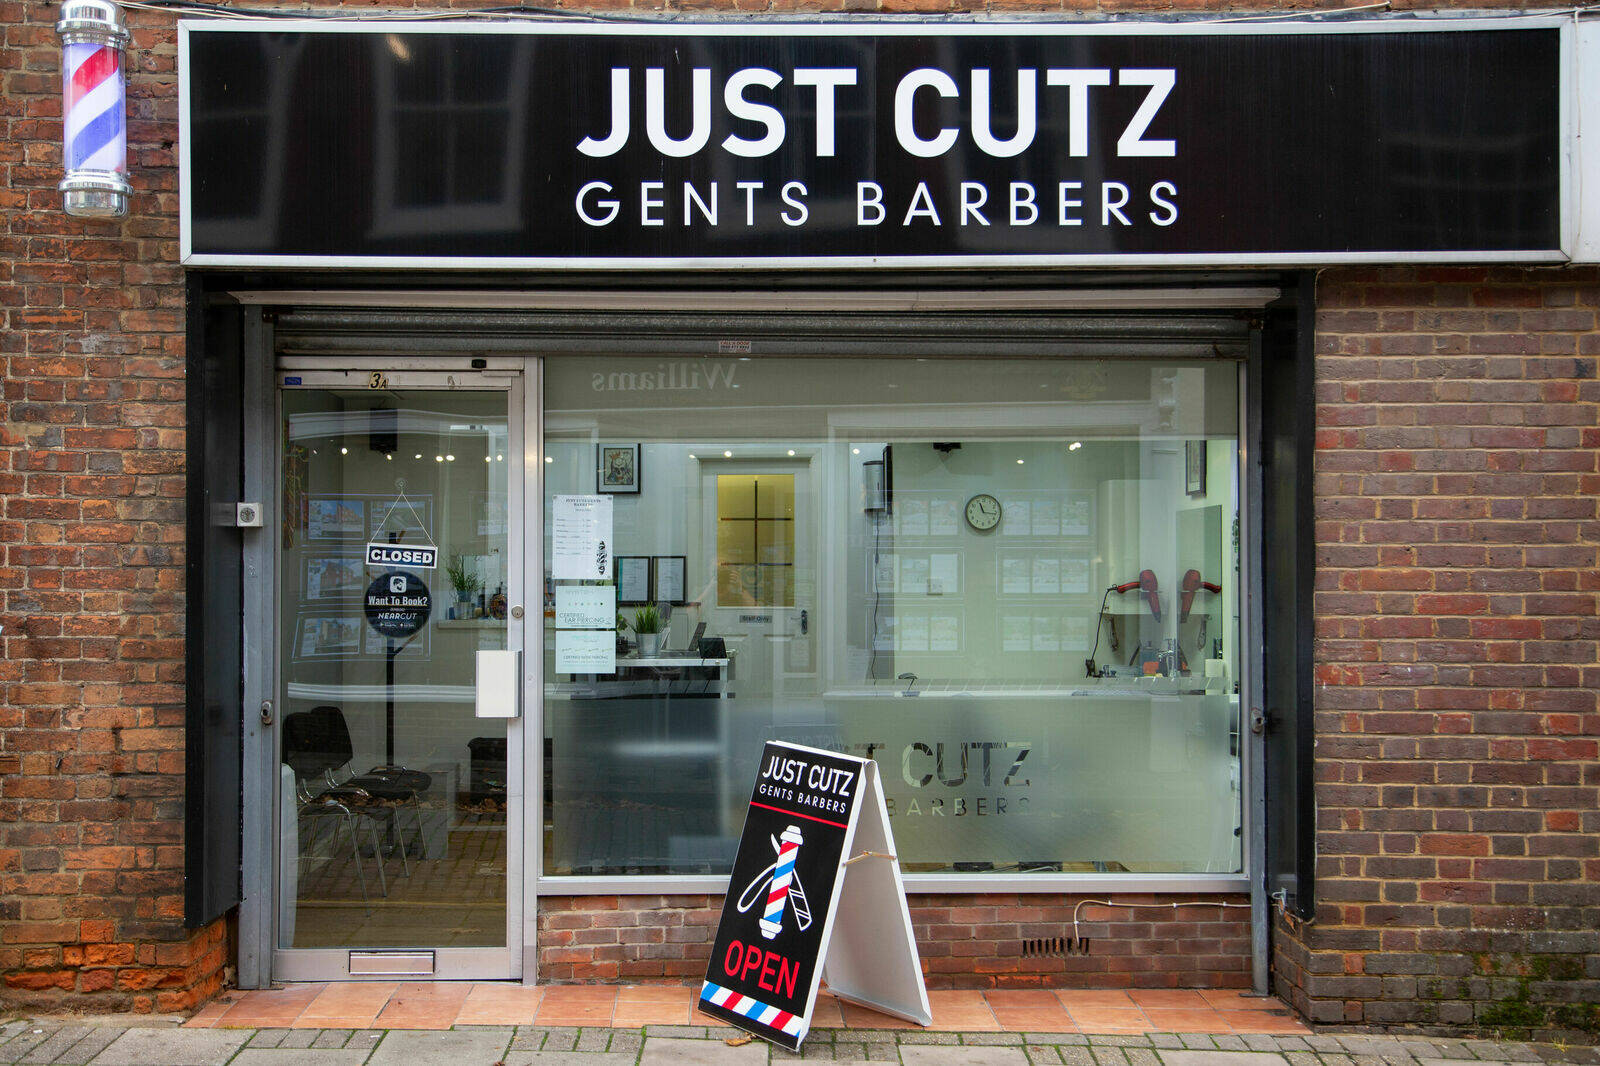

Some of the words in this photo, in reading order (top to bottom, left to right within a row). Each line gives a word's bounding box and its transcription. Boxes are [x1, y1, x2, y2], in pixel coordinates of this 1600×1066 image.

[576, 67, 857, 157] JUST
[894, 67, 1176, 158] CUTZ
[575, 181, 809, 227] GENTS
[857, 181, 1178, 227] BARBERS
[370, 549, 433, 564] CLOSED
[368, 596, 389, 605] Want
[391, 596, 401, 606] To
[402, 596, 428, 606] Book?
[377, 612, 418, 620] NEARCUT
[762, 755, 808, 786] JUST
[808, 764, 855, 797] CUTZ
[902, 741, 1032, 788] CUTZ
[759, 783, 794, 801] GENTS
[797, 792, 847, 814] BARBERS
[724, 939, 800, 1000] OPEN
